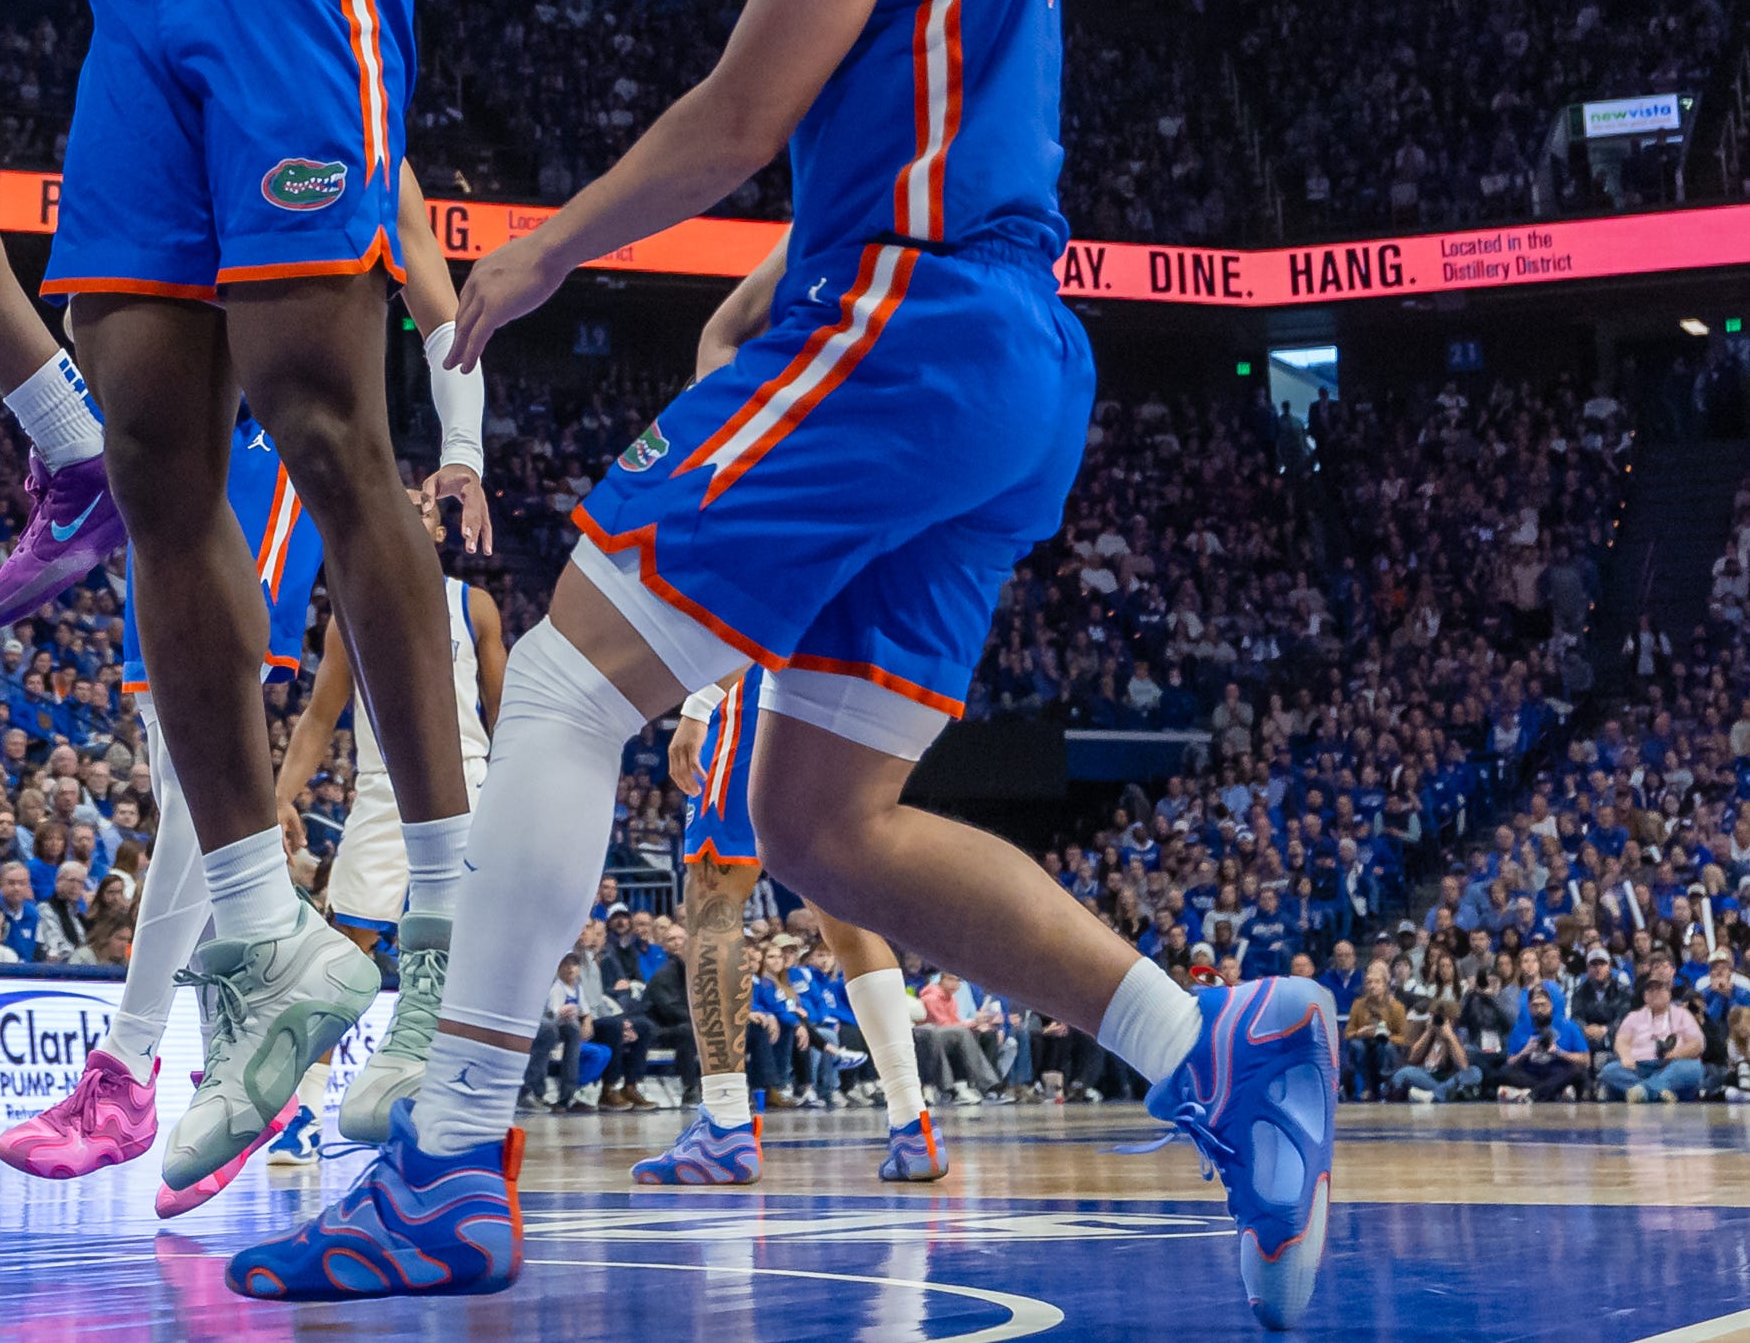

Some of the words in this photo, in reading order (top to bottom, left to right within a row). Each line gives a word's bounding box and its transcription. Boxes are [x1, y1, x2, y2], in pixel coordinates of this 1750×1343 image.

[1440, 233, 1505, 258] Located
[1508, 233, 1521, 252] in
[1527, 230, 1553, 250] the
[1150, 250, 1254, 299] DINE.
[1289, 243, 1417, 297] HANG.
[1442, 256, 1510, 283] Distillery
[1516, 252, 1573, 275] District
